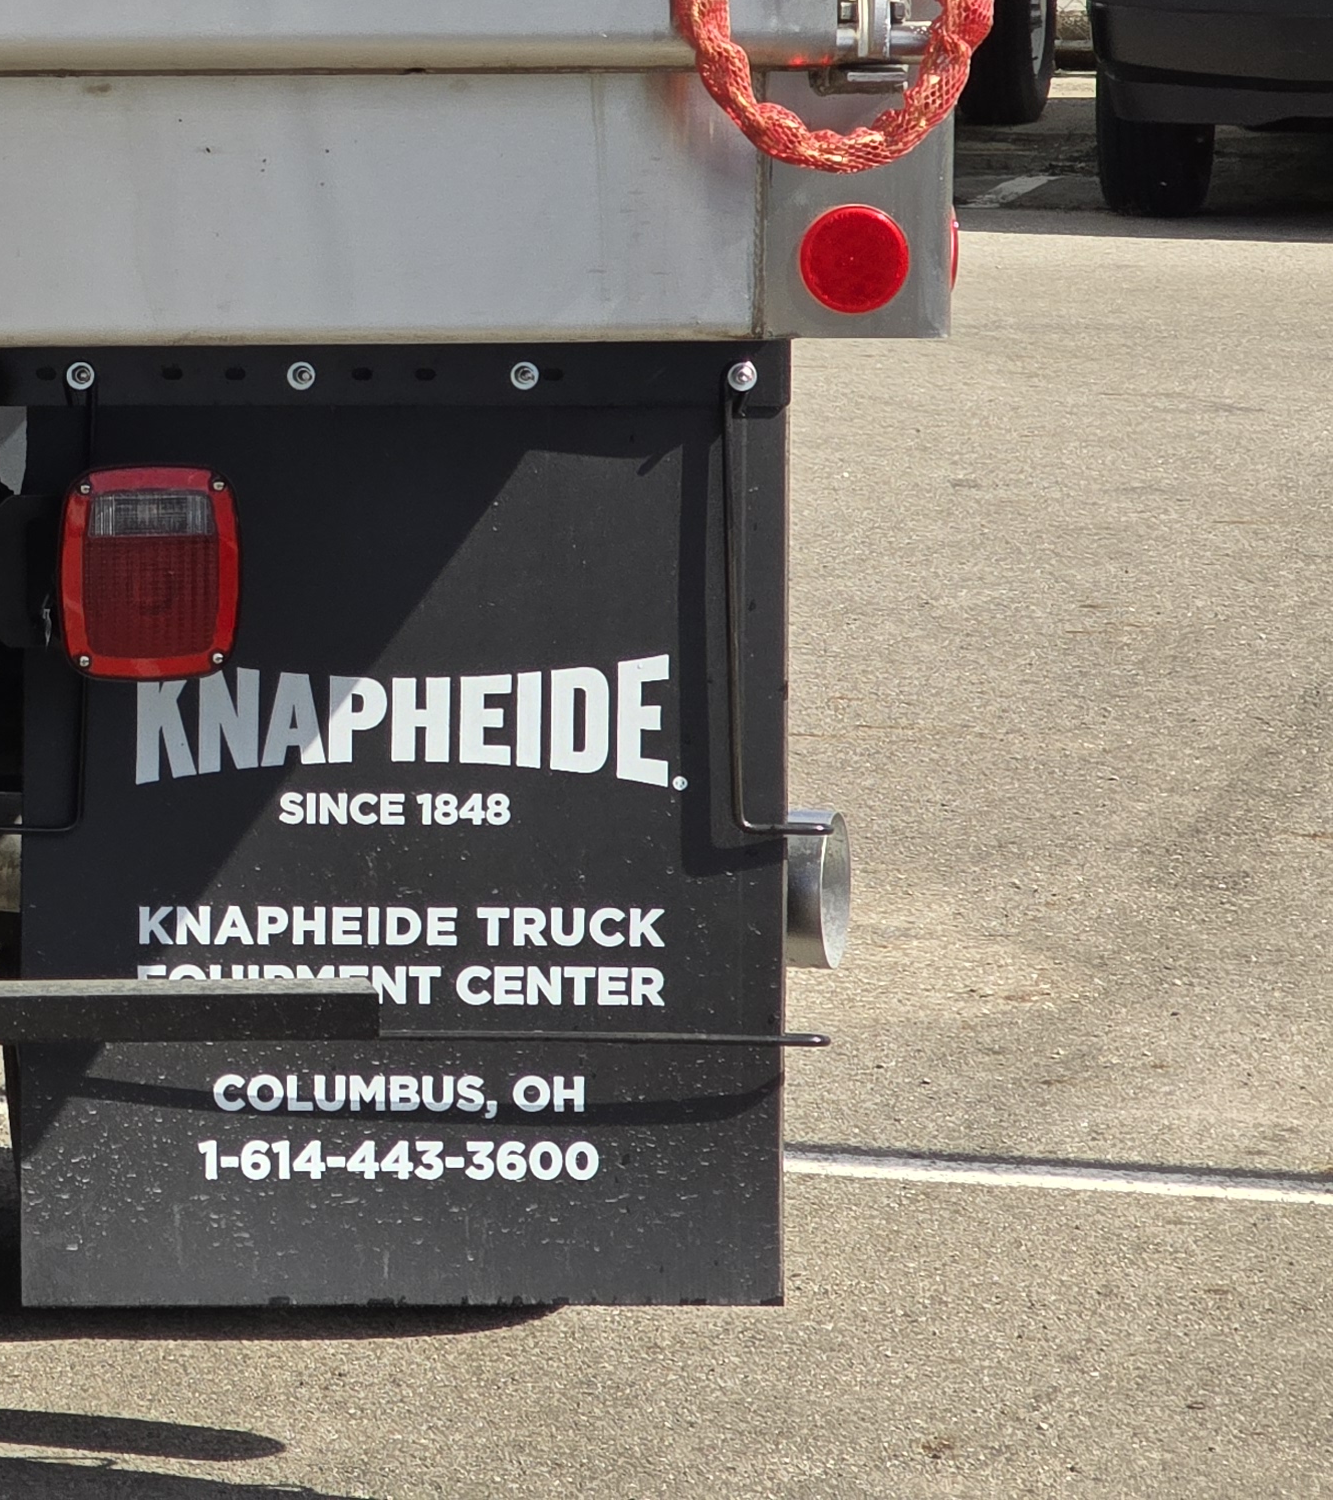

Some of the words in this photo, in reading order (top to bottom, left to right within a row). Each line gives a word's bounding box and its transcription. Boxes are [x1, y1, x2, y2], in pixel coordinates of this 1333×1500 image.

[135, 653, 670, 787] KNAPHEIDE
[278, 792, 405, 825] SINCE
[416, 792, 511, 825] 1848
[138, 905, 458, 947] KNAPHEIDE
[476, 906, 666, 947] TRUCK
[455, 965, 665, 1007] CENTER
[212, 1073, 498, 1119] COLUMBUS,
[512, 1074, 585, 1112] OH
[197, 1139, 600, 1182] 1-614-443-3600
